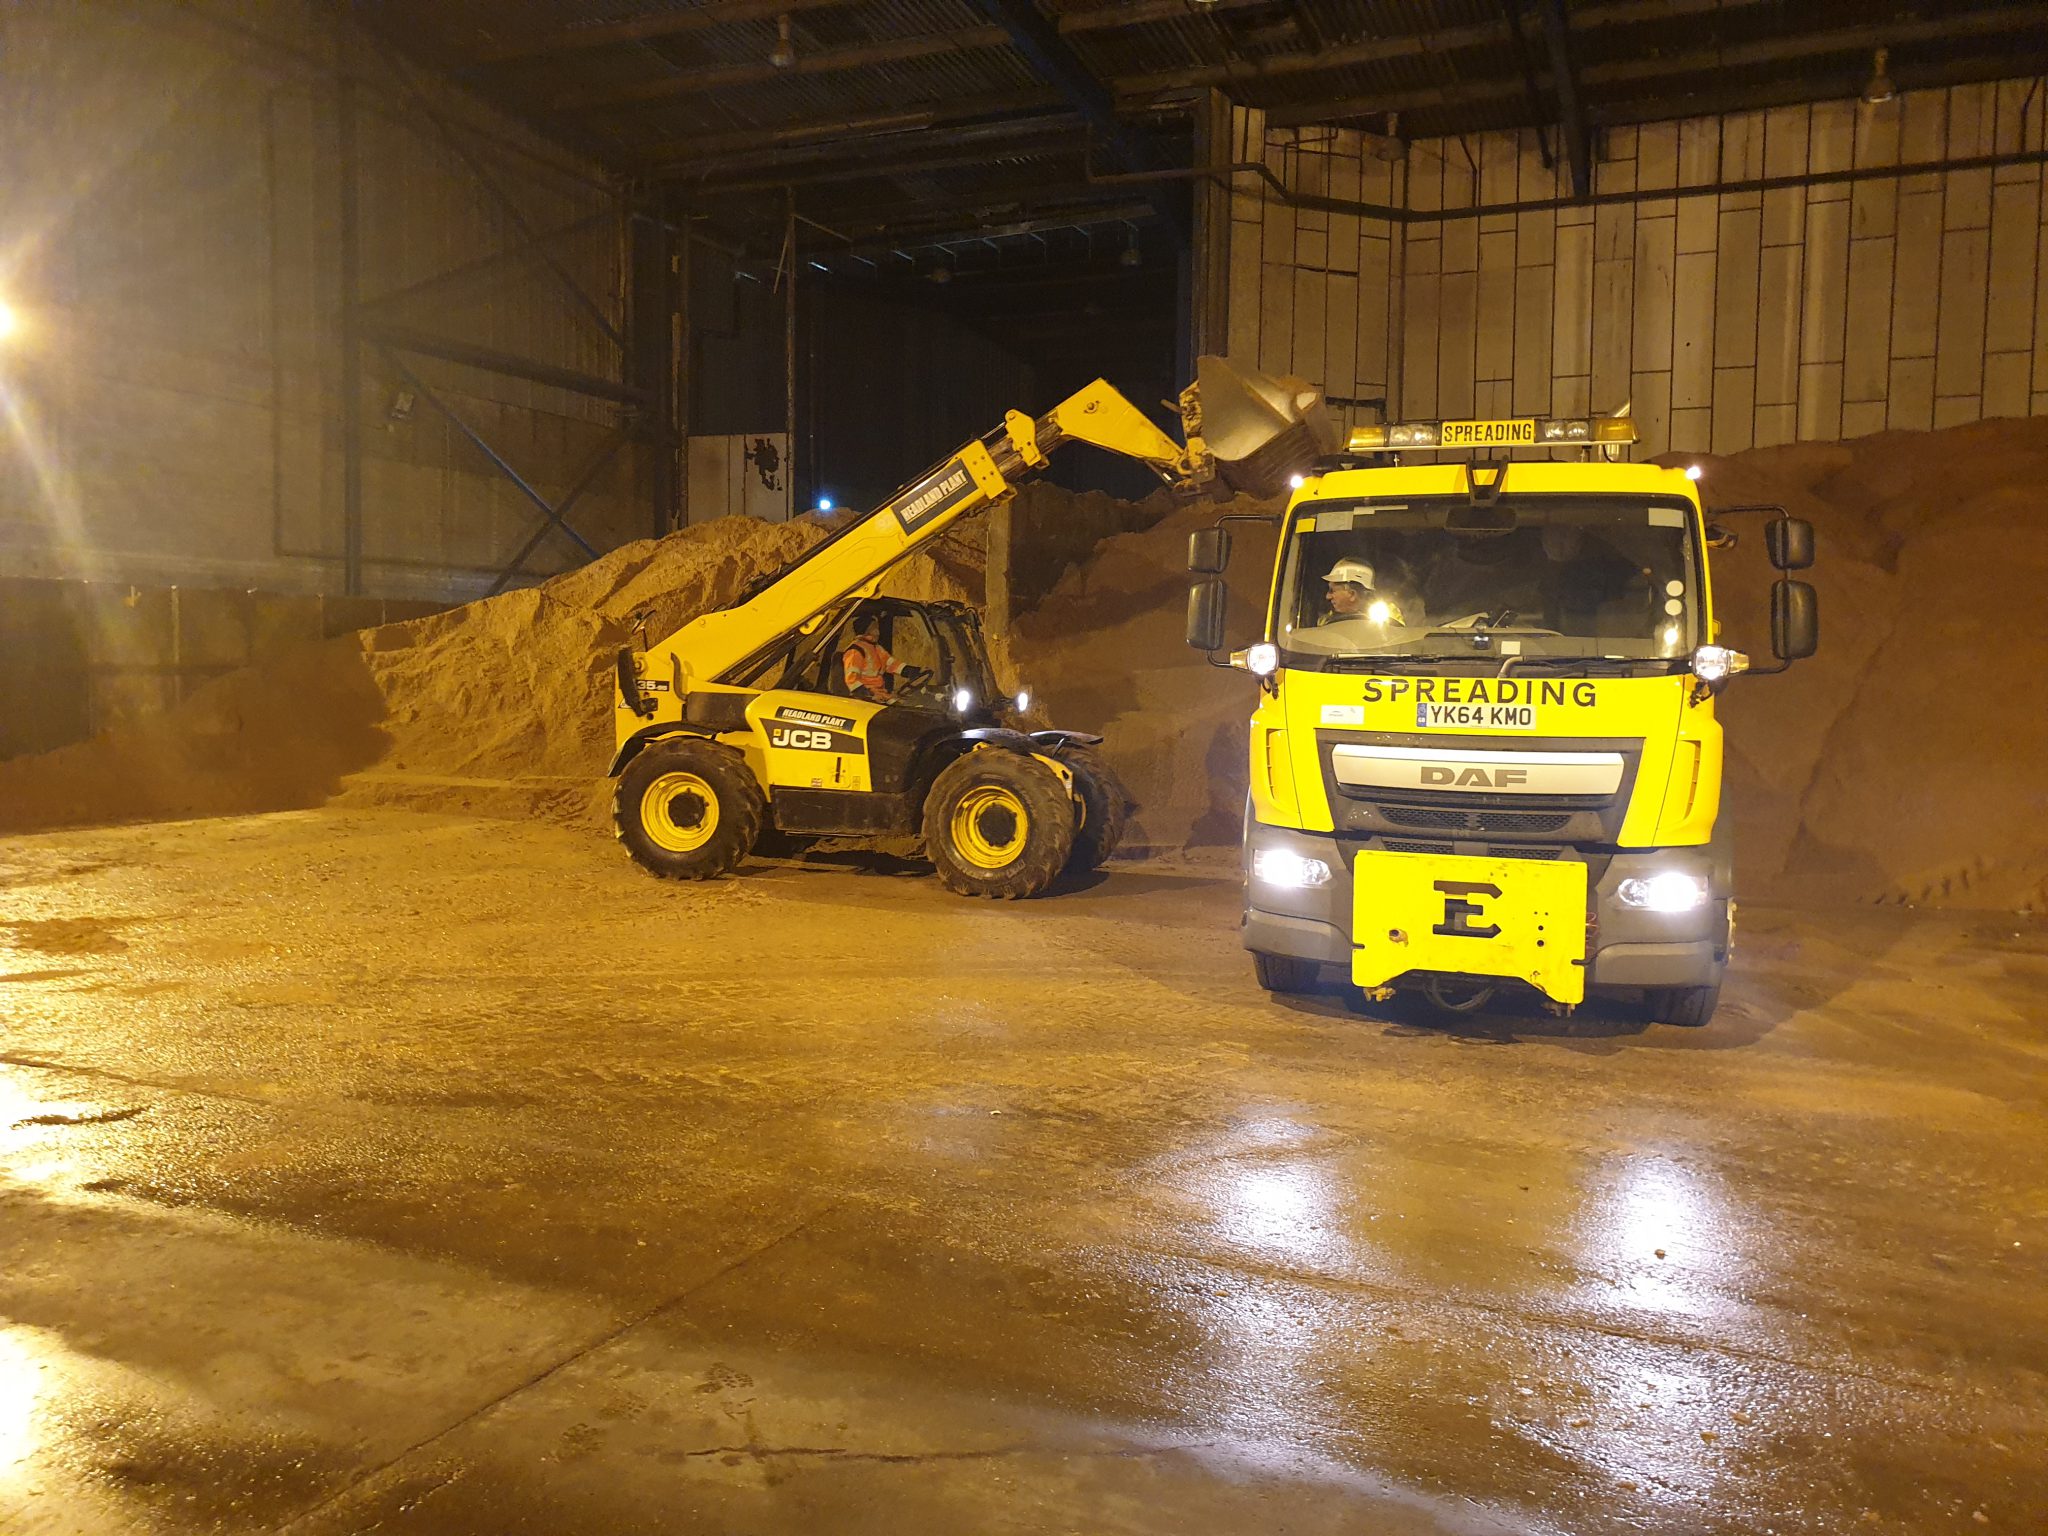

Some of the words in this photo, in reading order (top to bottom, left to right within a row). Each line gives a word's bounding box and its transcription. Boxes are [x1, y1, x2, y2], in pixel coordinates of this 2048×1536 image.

[1444, 423, 1532, 442] SPREADING
[900, 486, 944, 522] HEADLAND
[938, 469, 967, 496] PLANT
[1362, 678, 1597, 707] SPREADING
[782, 708, 822, 723] HEADLAND
[820, 715, 847, 728] PLANT
[1430, 705, 1484, 725] YK64
[1490, 706, 1532, 726] KMO
[772, 728, 832, 750] JCB
[1420, 766, 1528, 788] DAF
